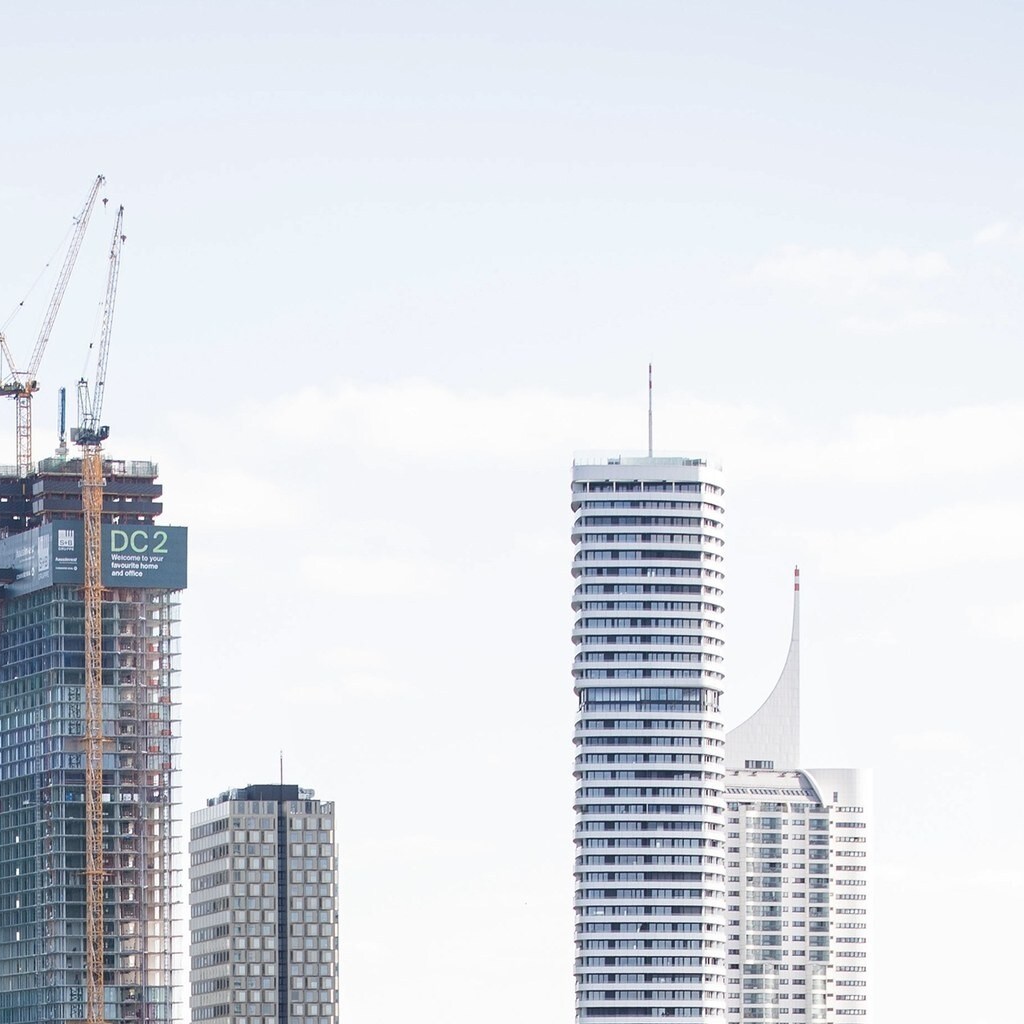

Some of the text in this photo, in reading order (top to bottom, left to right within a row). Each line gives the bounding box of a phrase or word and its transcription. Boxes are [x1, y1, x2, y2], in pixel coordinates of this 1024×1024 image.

[111, 530, 168, 553] DC 2
[111, 554, 140, 562] Welcome
[140, 562, 158, 570] home
